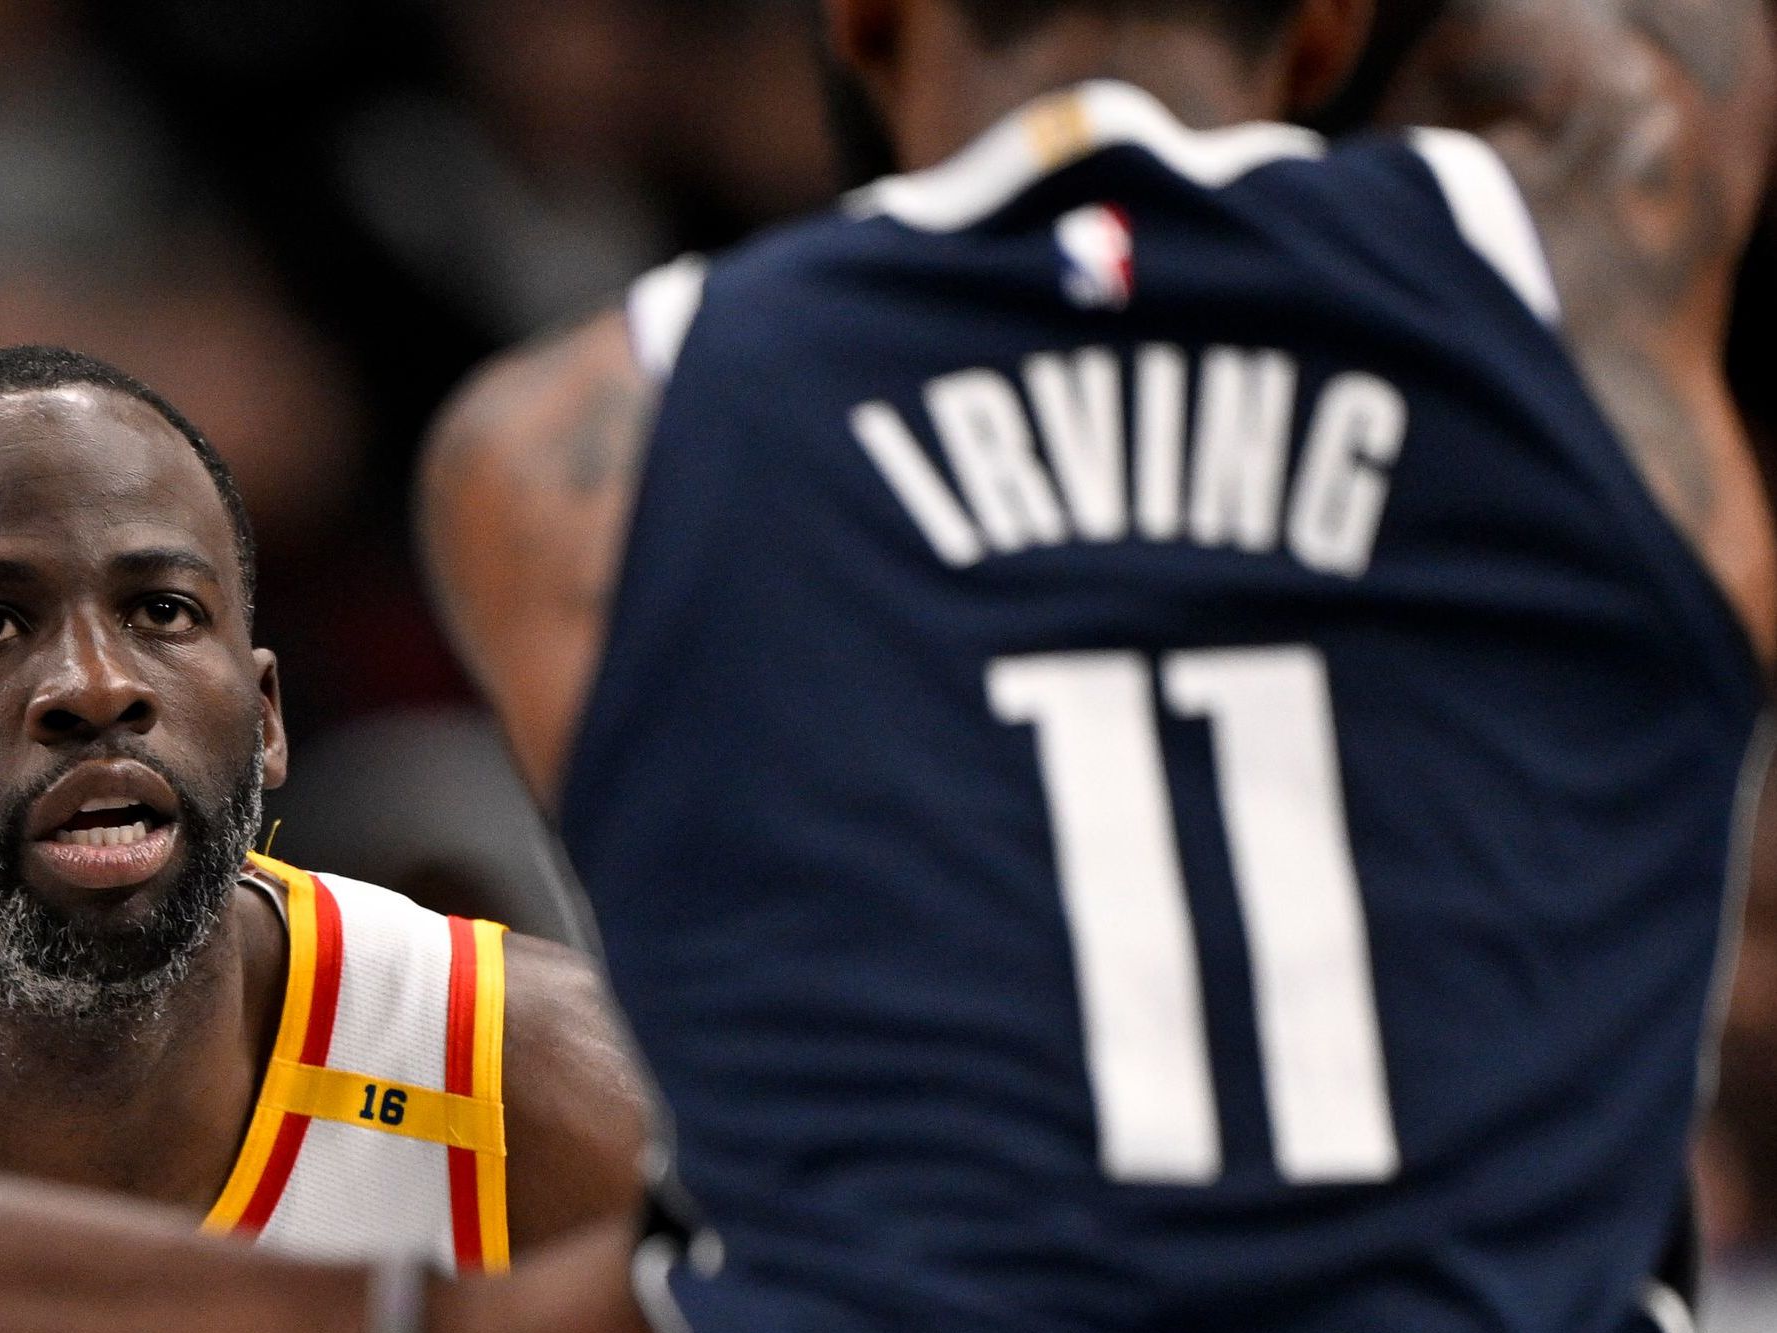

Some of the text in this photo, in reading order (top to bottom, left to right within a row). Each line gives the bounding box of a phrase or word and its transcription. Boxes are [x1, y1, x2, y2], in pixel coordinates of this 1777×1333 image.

[848, 341, 1409, 580] IRVING
[984, 644, 1403, 1186] 11
[359, 1084, 408, 1126] 16
